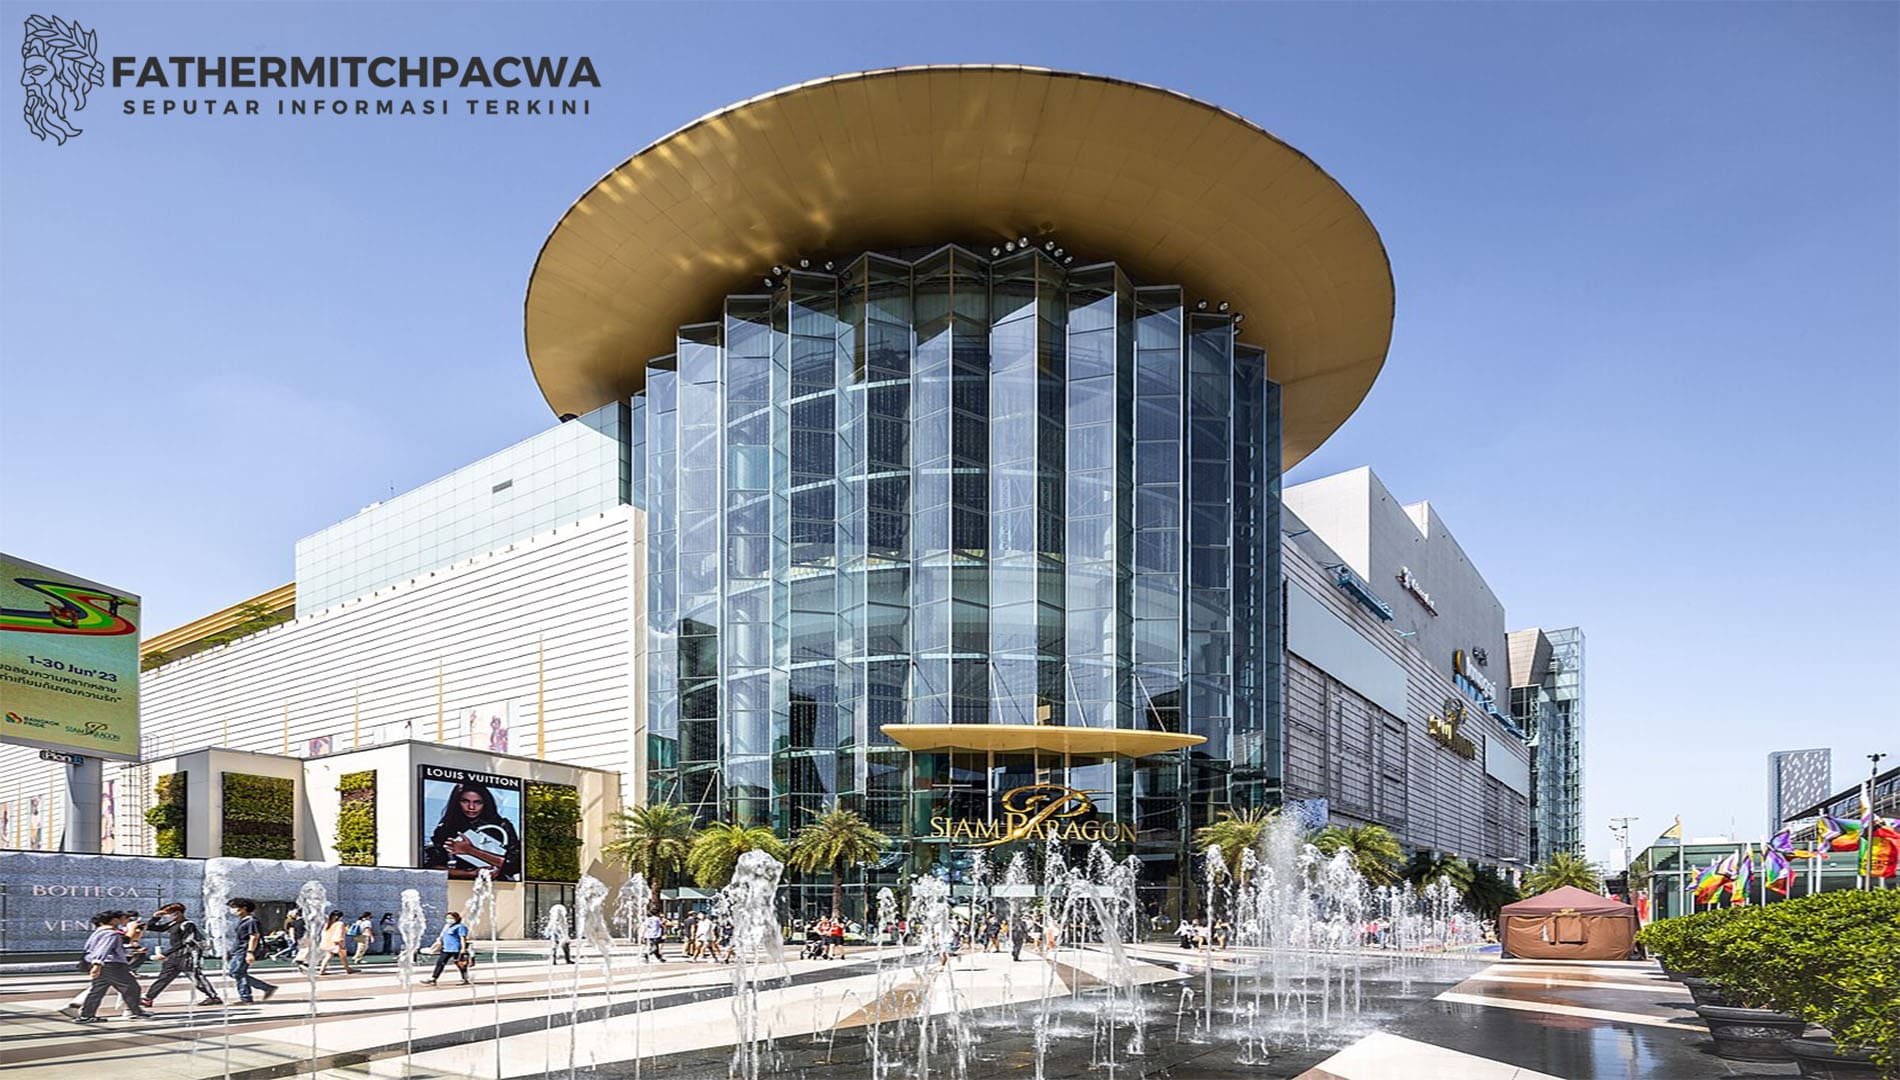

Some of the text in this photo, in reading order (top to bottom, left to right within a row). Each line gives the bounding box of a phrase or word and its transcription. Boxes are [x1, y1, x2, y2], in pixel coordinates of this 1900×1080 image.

[28, 655, 65, 671] 1-30
[427, 767, 519, 787] LOUIS VUITTON
[930, 811, 1137, 843] SIAM PARAGON
